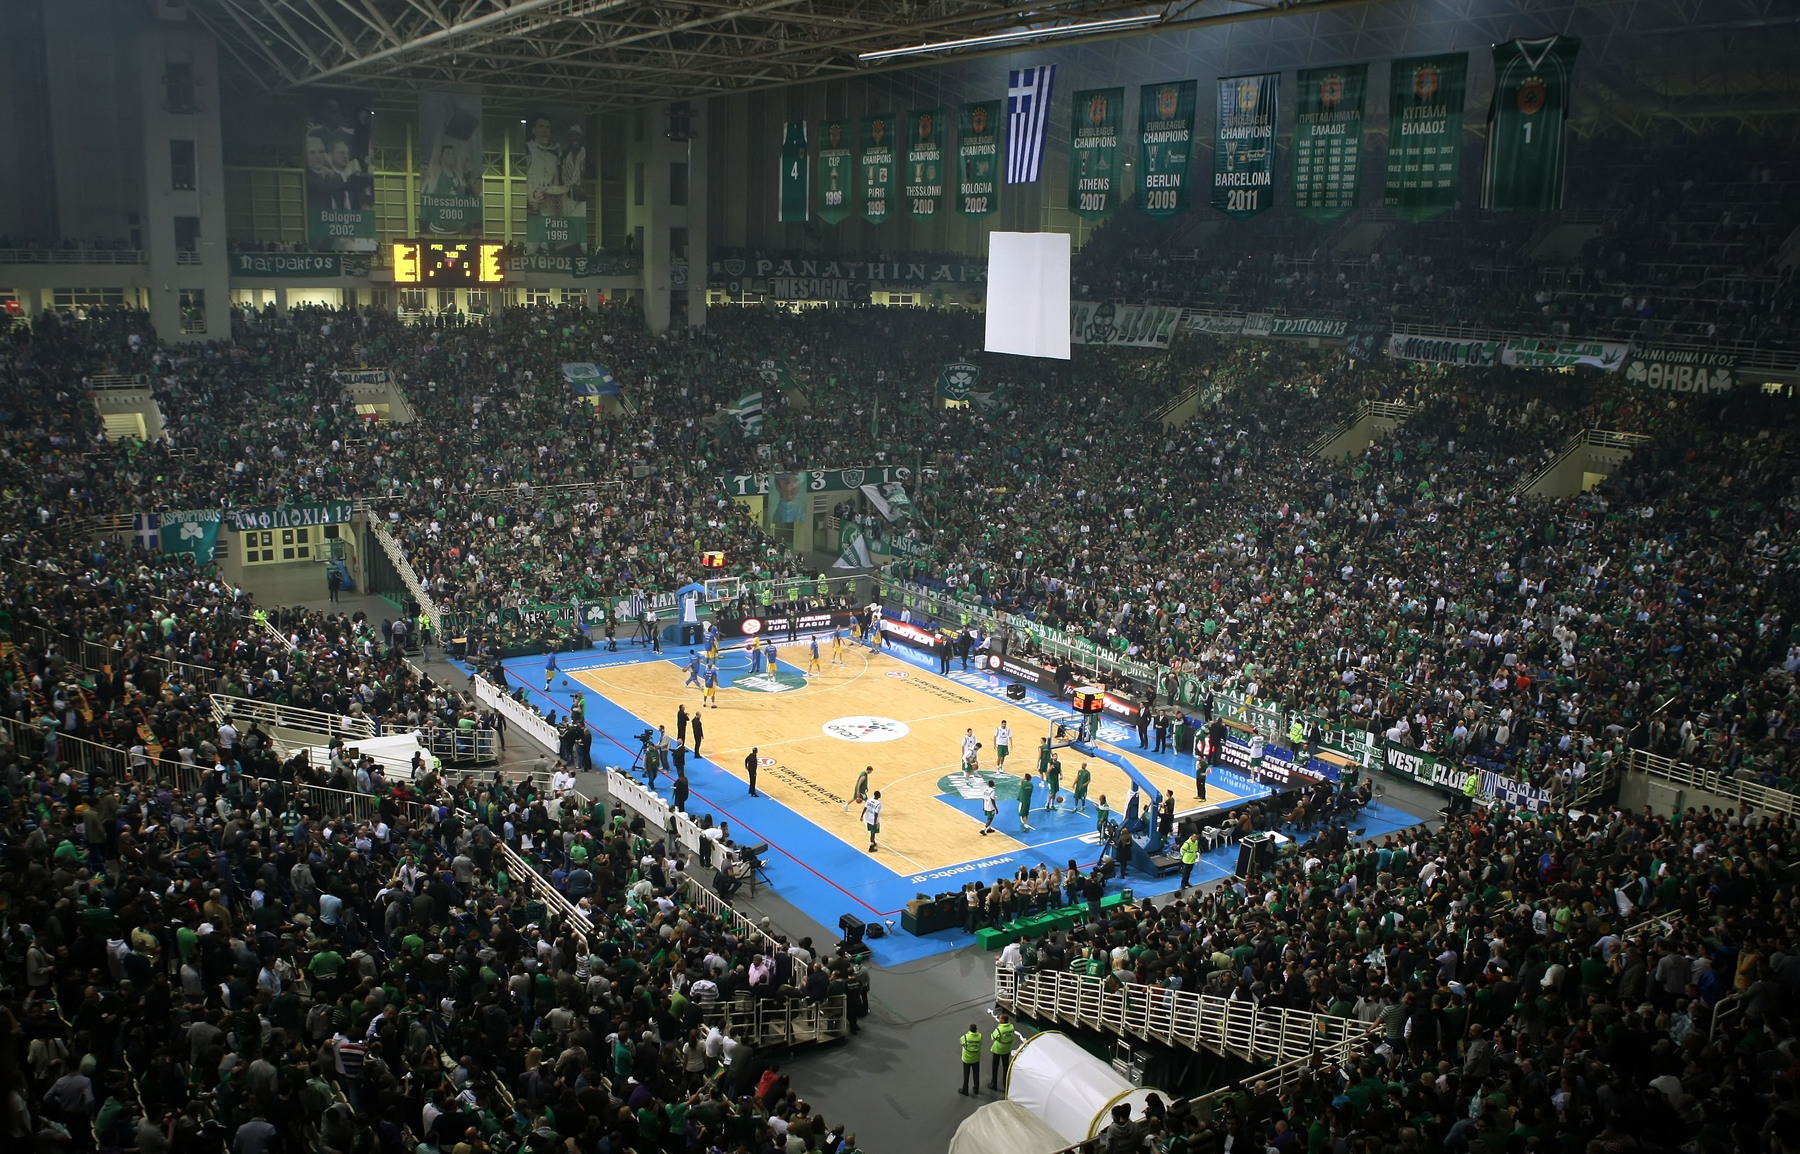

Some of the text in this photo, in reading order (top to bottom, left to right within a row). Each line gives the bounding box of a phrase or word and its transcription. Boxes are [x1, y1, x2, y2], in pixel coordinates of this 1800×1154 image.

[1403, 105, 1446, 119] ΚΥΠΕΛΛΑ
[1146, 119, 1186, 130] EUROLEAGUE
[1311, 123, 1346, 136] ΕΛΛΑΔΟΣ
[1401, 121, 1446, 135] ΕΛΛΑΔΟΣ
[1079, 127, 1114, 137] EUROLEAGUE
[1143, 130, 1189, 144] CHAMPIONS
[1220, 125, 1271, 140] CHAMPIONS
[1523, 122, 1533, 144] 1
[1074, 136, 1117, 148] CHAMPIONS
[961, 144, 995, 156] CHAMPIONS
[863, 154, 892, 165] CHAMPIONS
[791, 161, 798, 180] 4
[1078, 178, 1109, 190] ATHENS
[1146, 174, 1180, 187] BERLIN
[1215, 170, 1271, 187] BARCELONA
[961, 182, 992, 194] BOLOGNA
[422, 196, 480, 208] Thessaloniki
[964, 197, 987, 213] 2002
[1080, 193, 1106, 210] 2007
[1147, 190, 1177, 209] 2009
[1227, 189, 1258, 211] 2011
[321, 210, 362, 224] Bologna
[439, 210, 463, 220] 2000
[329, 224, 355, 236] 2002
[544, 218, 569, 229] Paris
[545, 230, 569, 241] 1996
[1648, 363, 1710, 394] ΘΗΒΑ
[336, 505, 351, 522] 13
[892, 535, 912, 552] EAST
[800, 614, 831, 622] AIRLINES
[1002, 666, 1039, 683] EUROLEAGUE
[1388, 746, 1423, 776] WEST
[763, 767, 832, 806] EUROLEAGUE
[777, 765, 846, 805] TURKISH AIRLINES
[911, 856, 1014, 885] www.paobc.gr
